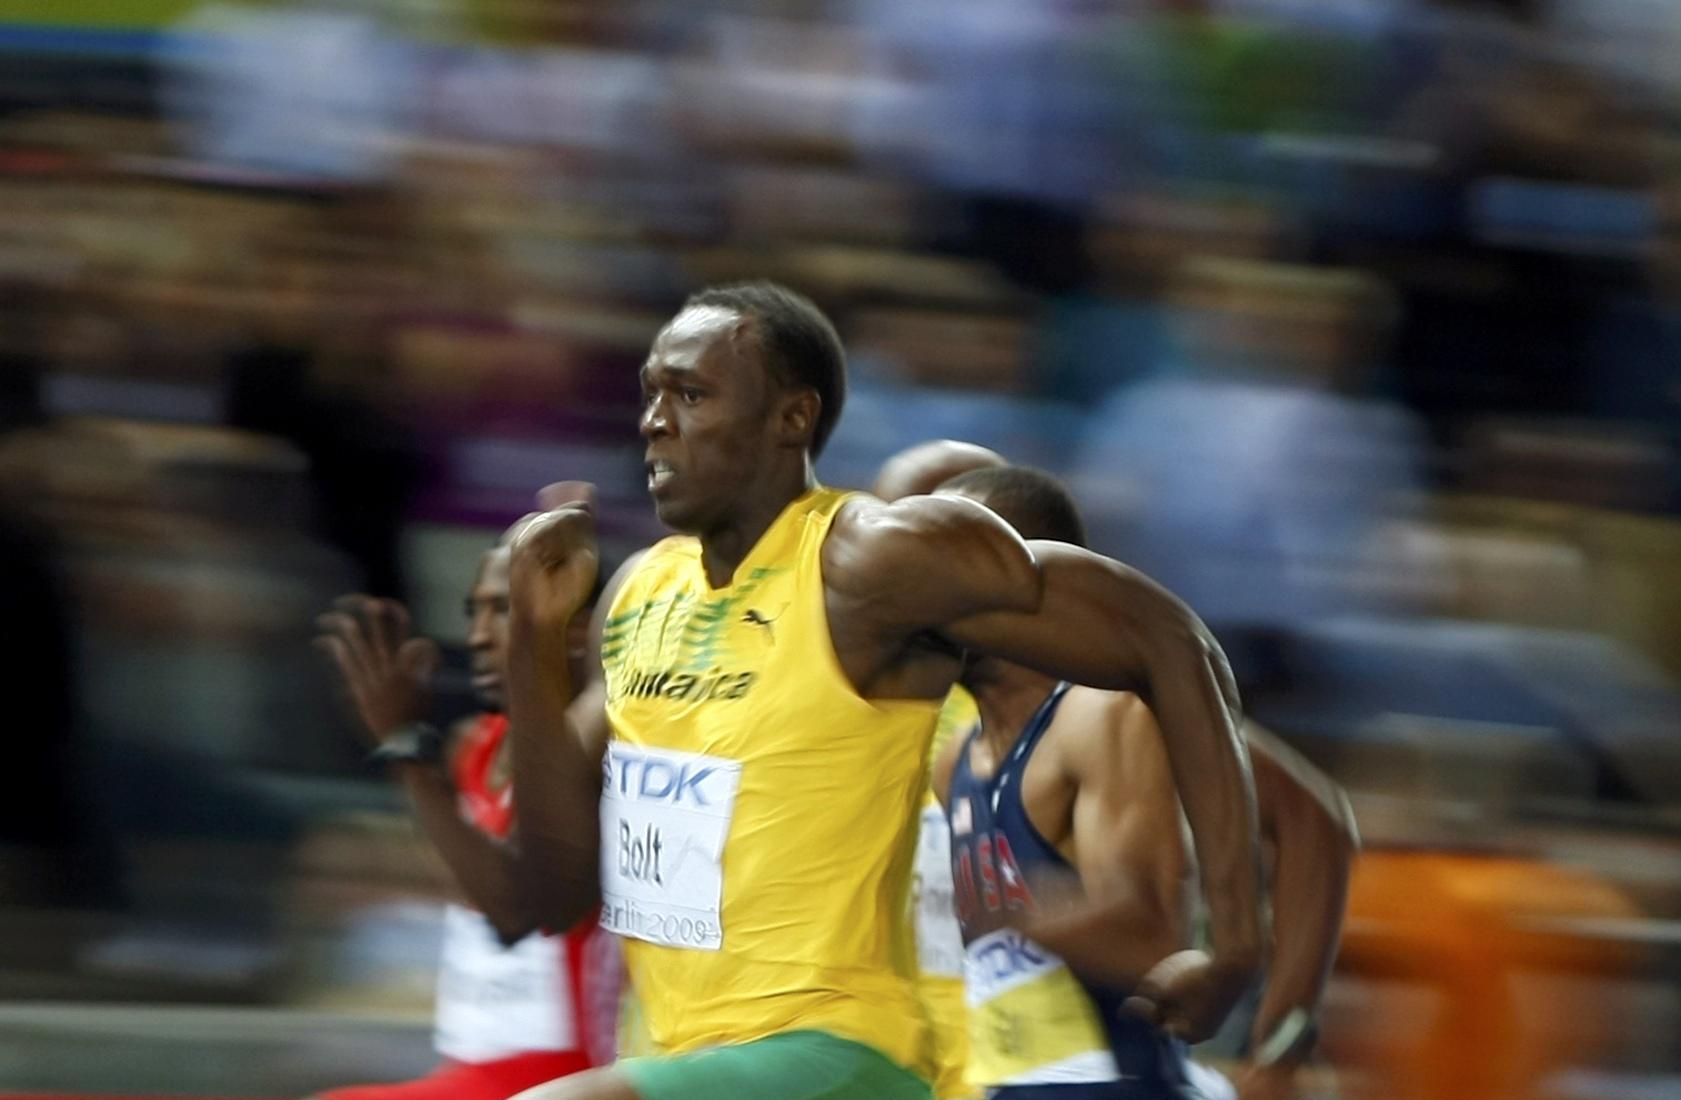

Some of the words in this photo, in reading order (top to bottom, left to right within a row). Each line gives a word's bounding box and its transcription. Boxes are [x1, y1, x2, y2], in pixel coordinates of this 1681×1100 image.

[611, 755, 719, 806] TDK
[619, 817, 662, 888] Bolt
[601, 899, 644, 931] erlin
